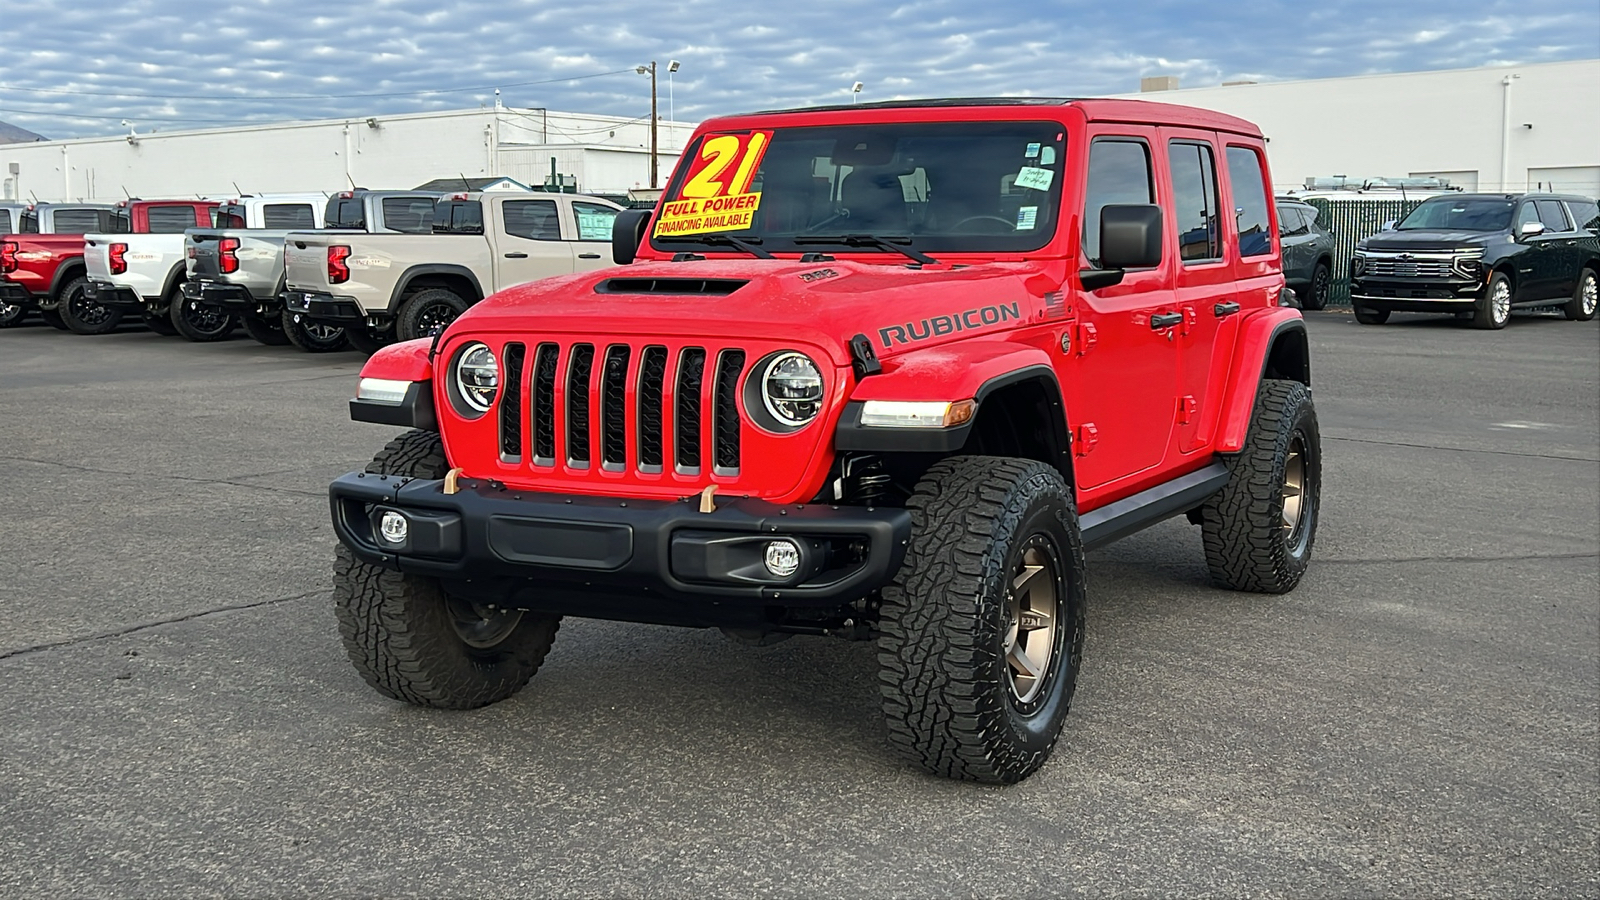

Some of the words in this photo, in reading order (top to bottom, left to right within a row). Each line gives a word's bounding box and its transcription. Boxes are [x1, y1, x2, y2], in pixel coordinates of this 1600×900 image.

[682, 132, 767, 198] 21
[656, 218, 702, 234] FINANCING
[702, 212, 749, 229] AVAILABLE
[663, 202, 698, 217] FULL
[702, 195, 757, 212] POWER
[879, 301, 1020, 347] RUBICON
